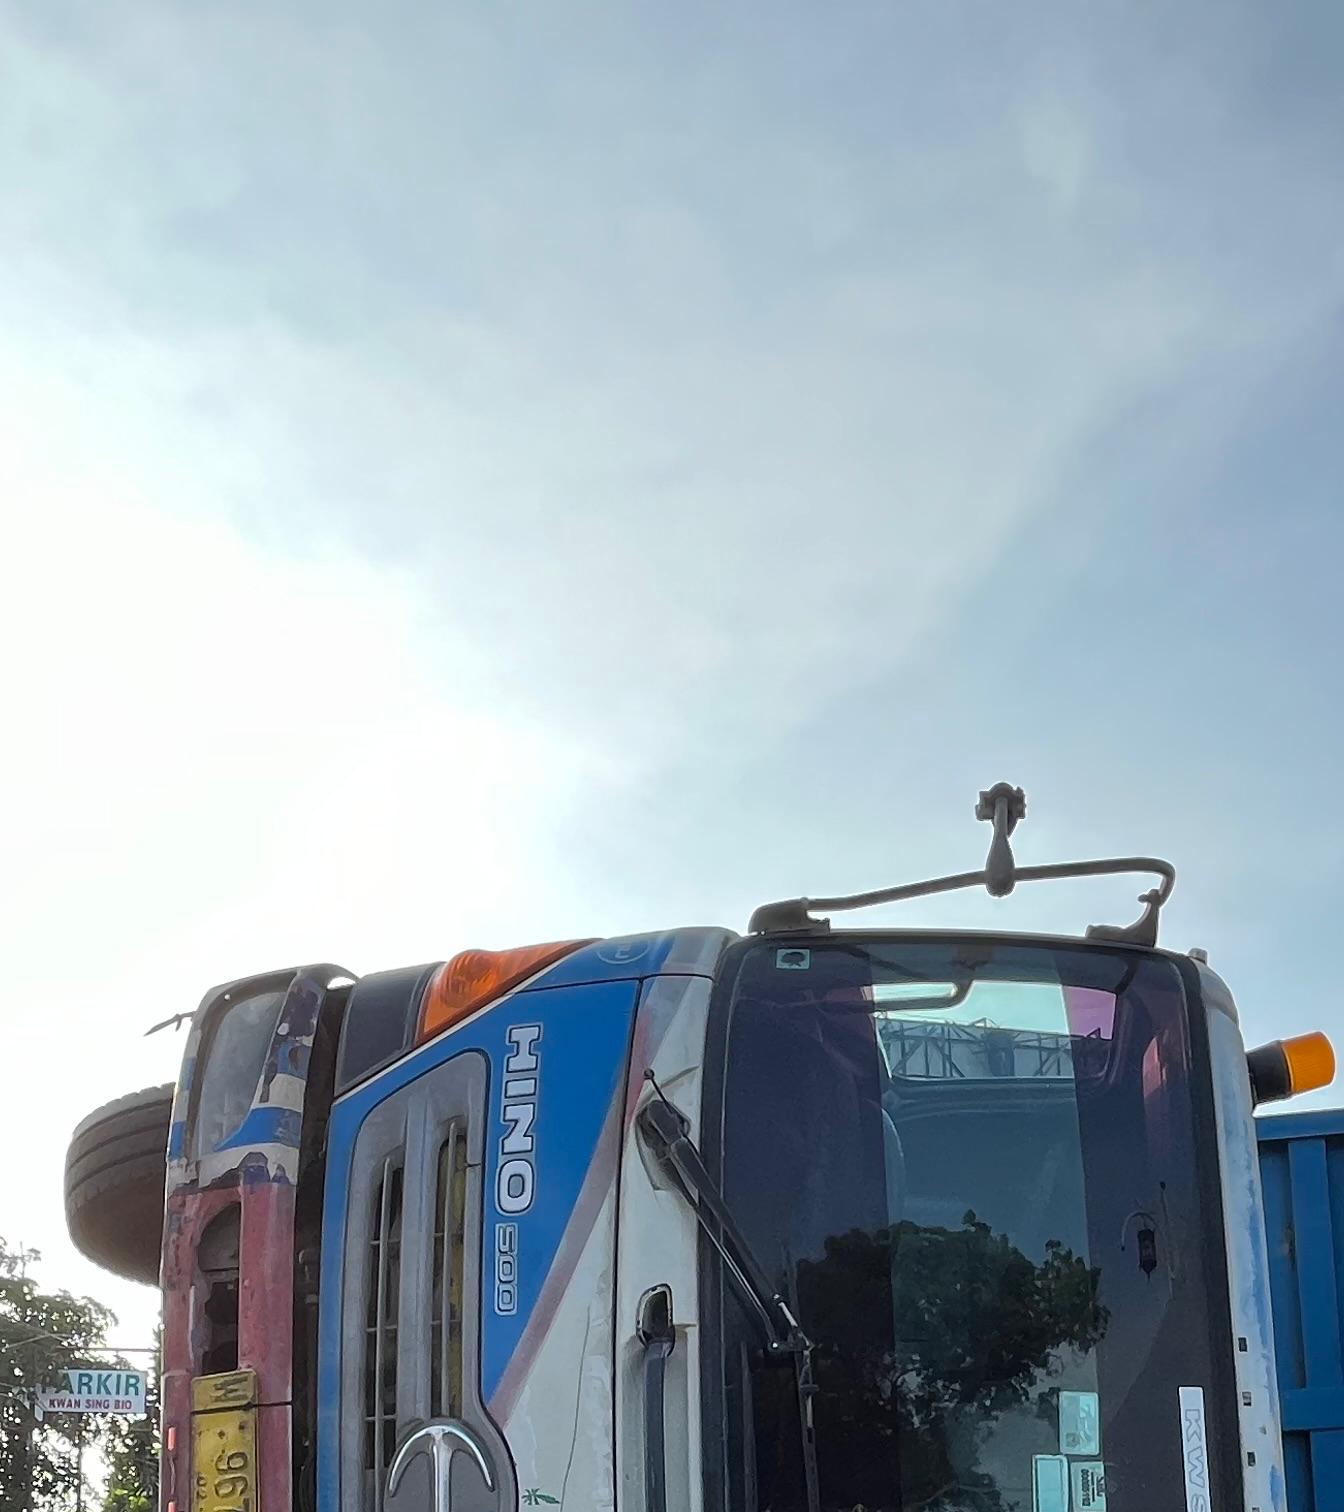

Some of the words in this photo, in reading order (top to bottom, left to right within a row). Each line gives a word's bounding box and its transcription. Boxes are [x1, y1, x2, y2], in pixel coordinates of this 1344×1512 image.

[497, 1024, 542, 1215] HINO
[496, 1223, 517, 1314] 500
[49, 1399, 81, 1409] KWAN
[84, 1399, 110, 1409] SING
[114, 1400, 132, 1410] BIO
[209, 1376, 249, 1402] W
